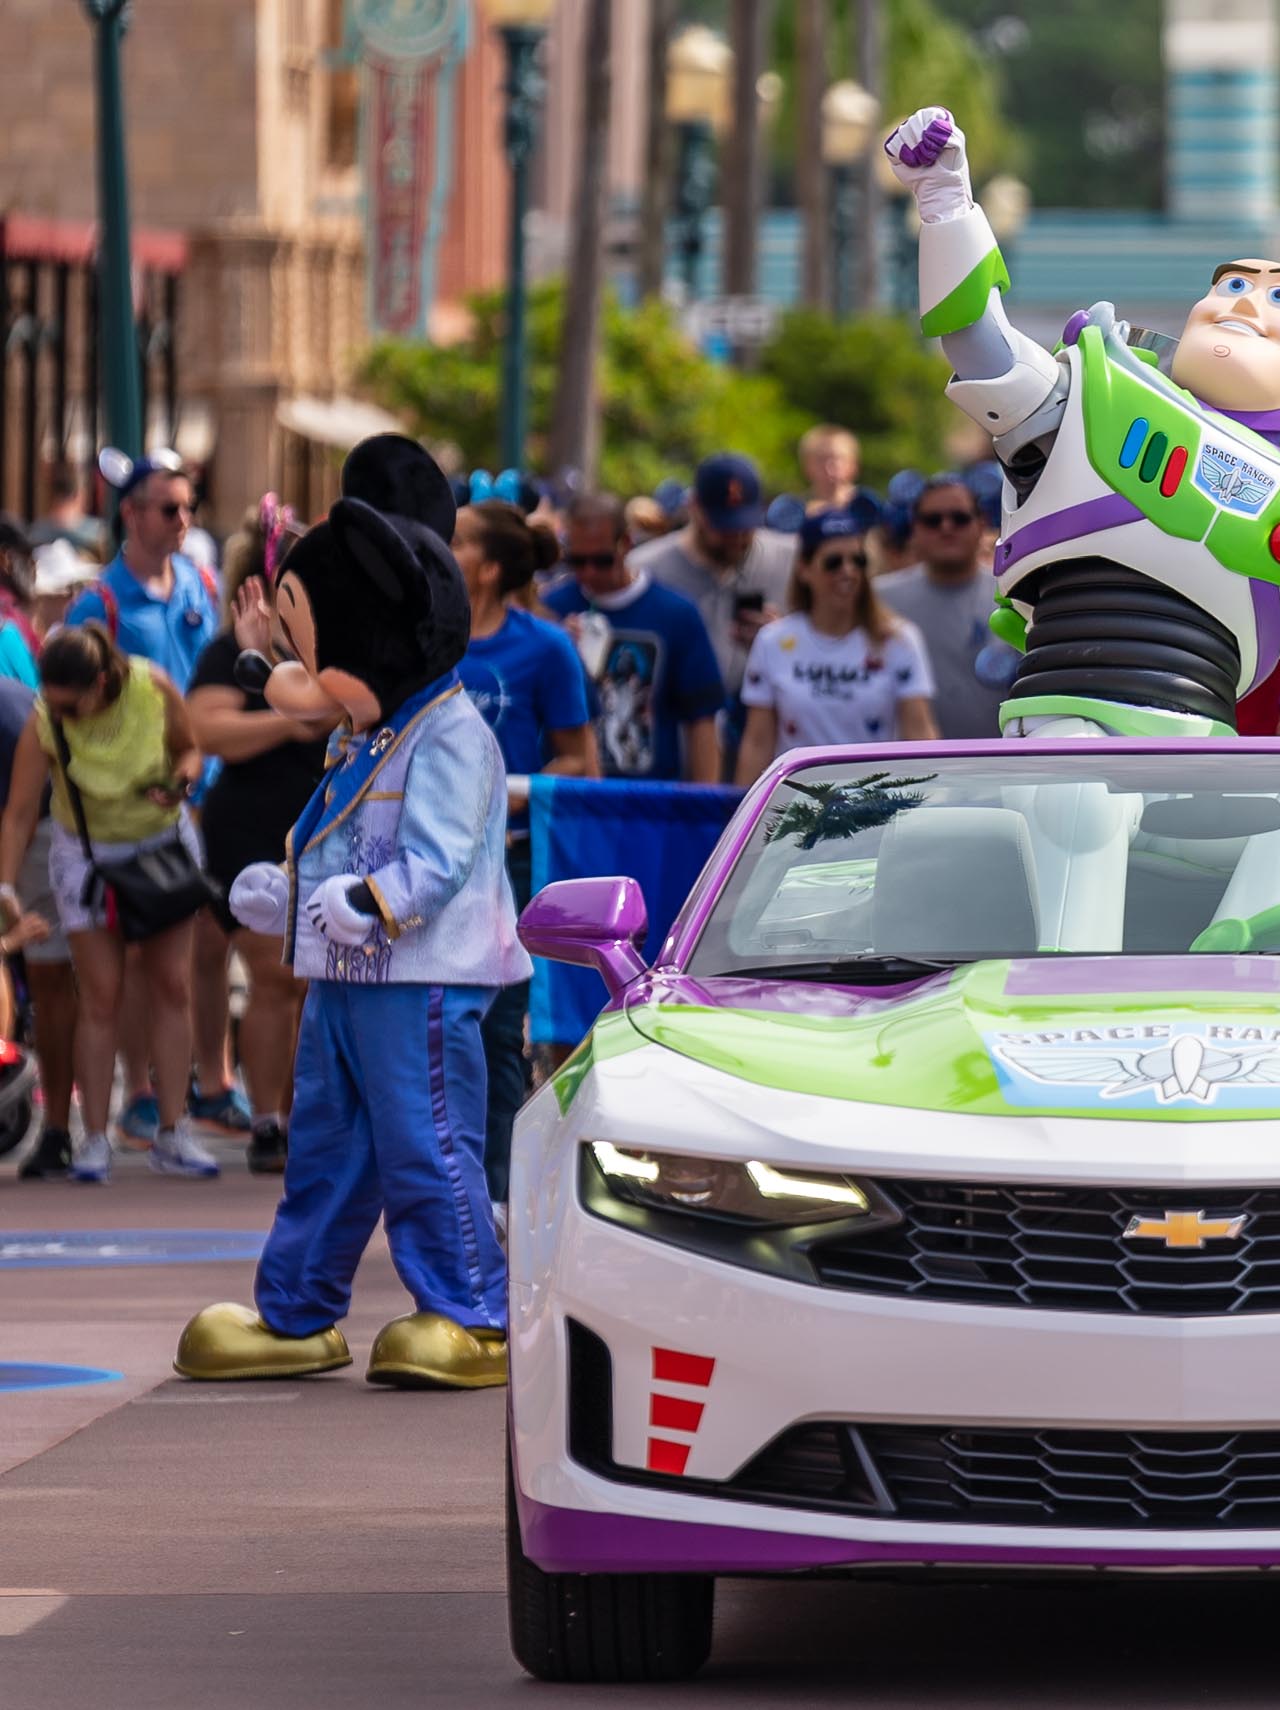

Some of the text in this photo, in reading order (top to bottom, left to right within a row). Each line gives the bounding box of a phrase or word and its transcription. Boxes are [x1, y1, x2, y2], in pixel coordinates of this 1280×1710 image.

[1205, 444, 1274, 487] SPACE RANGER
[999, 1025, 1171, 1045] SPACE
